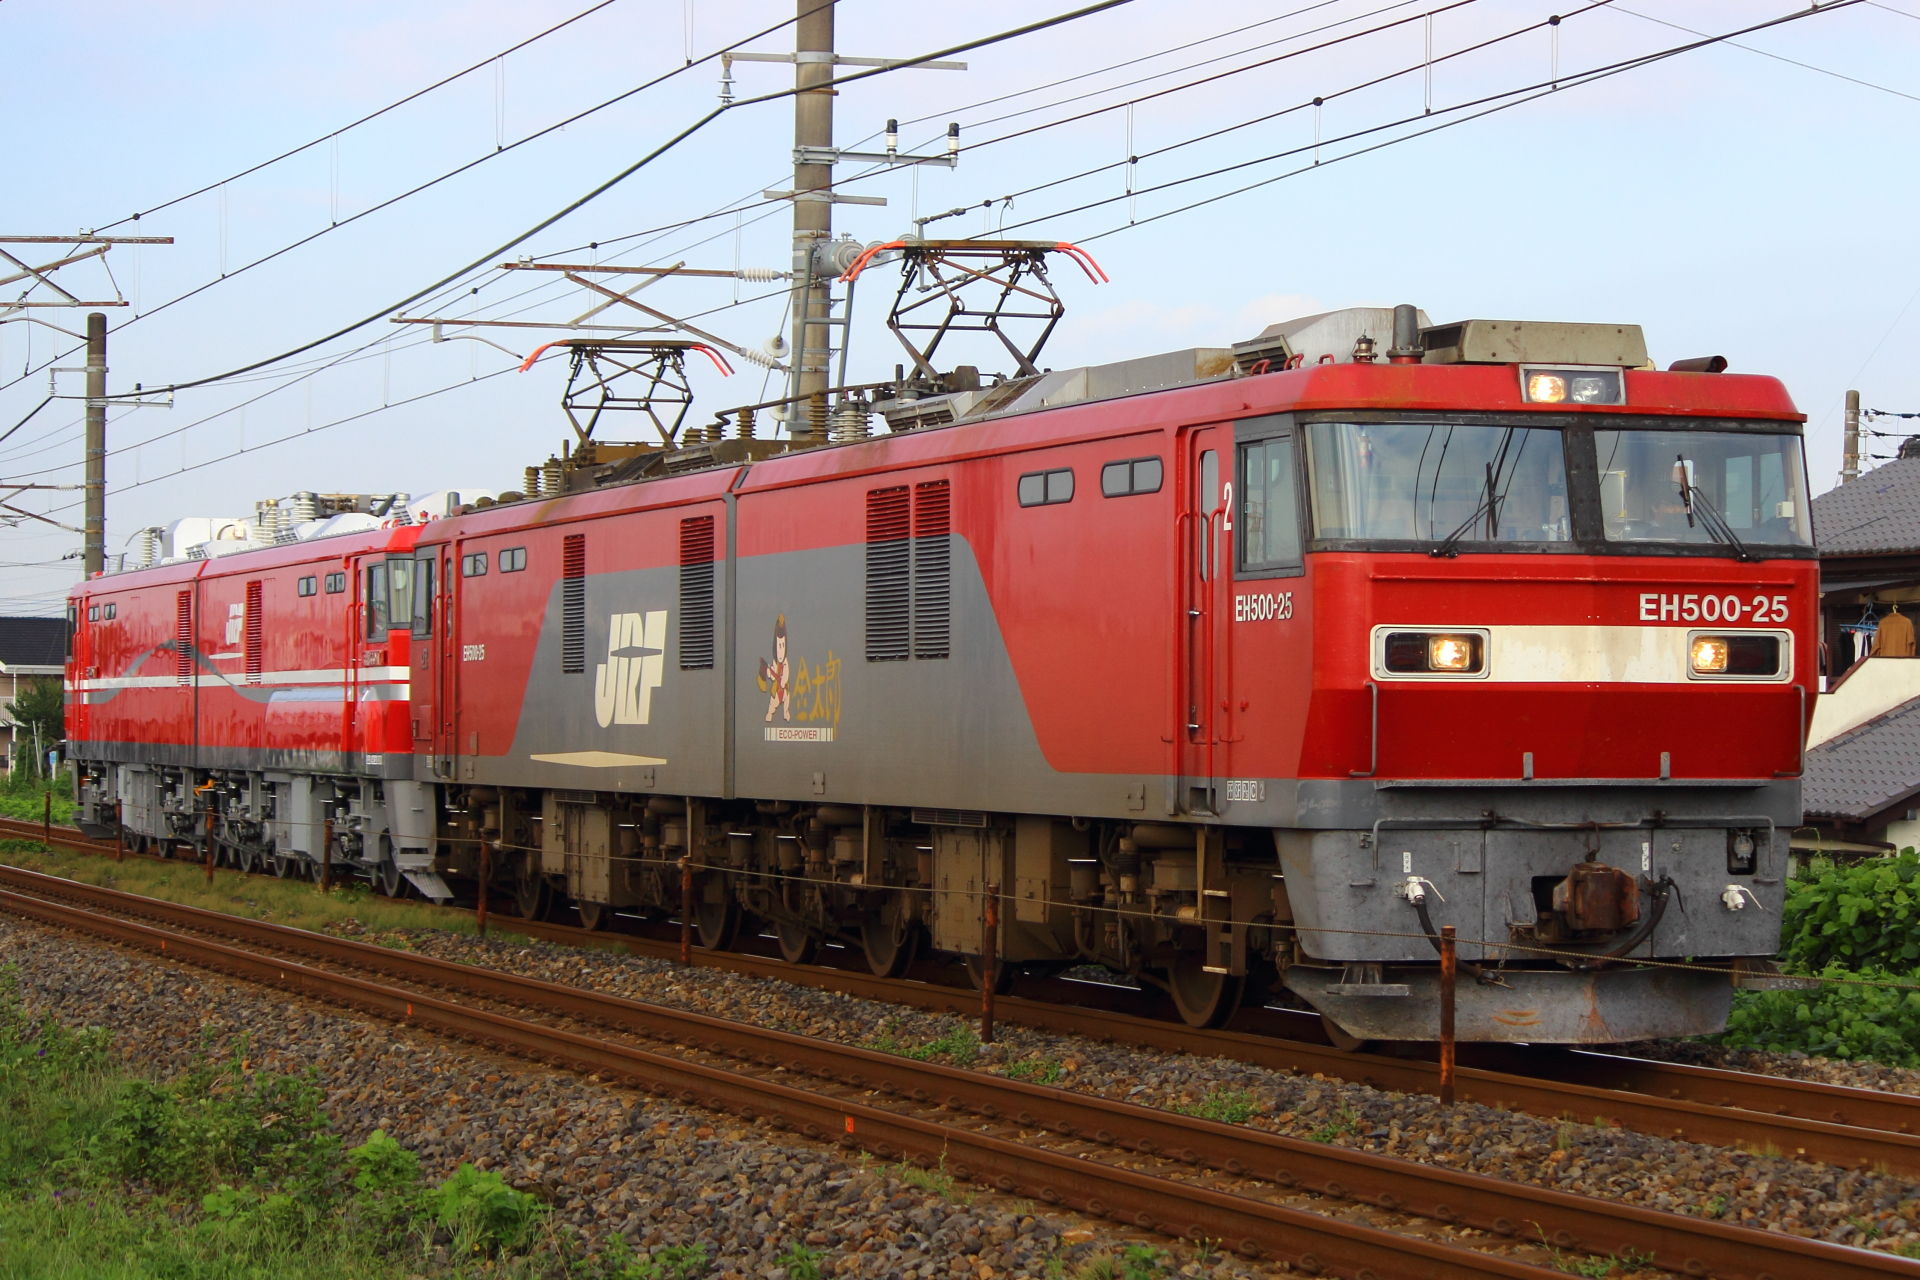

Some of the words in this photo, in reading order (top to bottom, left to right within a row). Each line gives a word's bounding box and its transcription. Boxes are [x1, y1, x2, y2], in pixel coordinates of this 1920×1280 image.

[1223, 482, 1232, 531] 2
[1235, 592, 1293, 622] EH500-25
[1639, 593, 1789, 622] EH500-25
[594, 610, 668, 729] JRF
[778, 729, 818, 740] ECO-POWER
